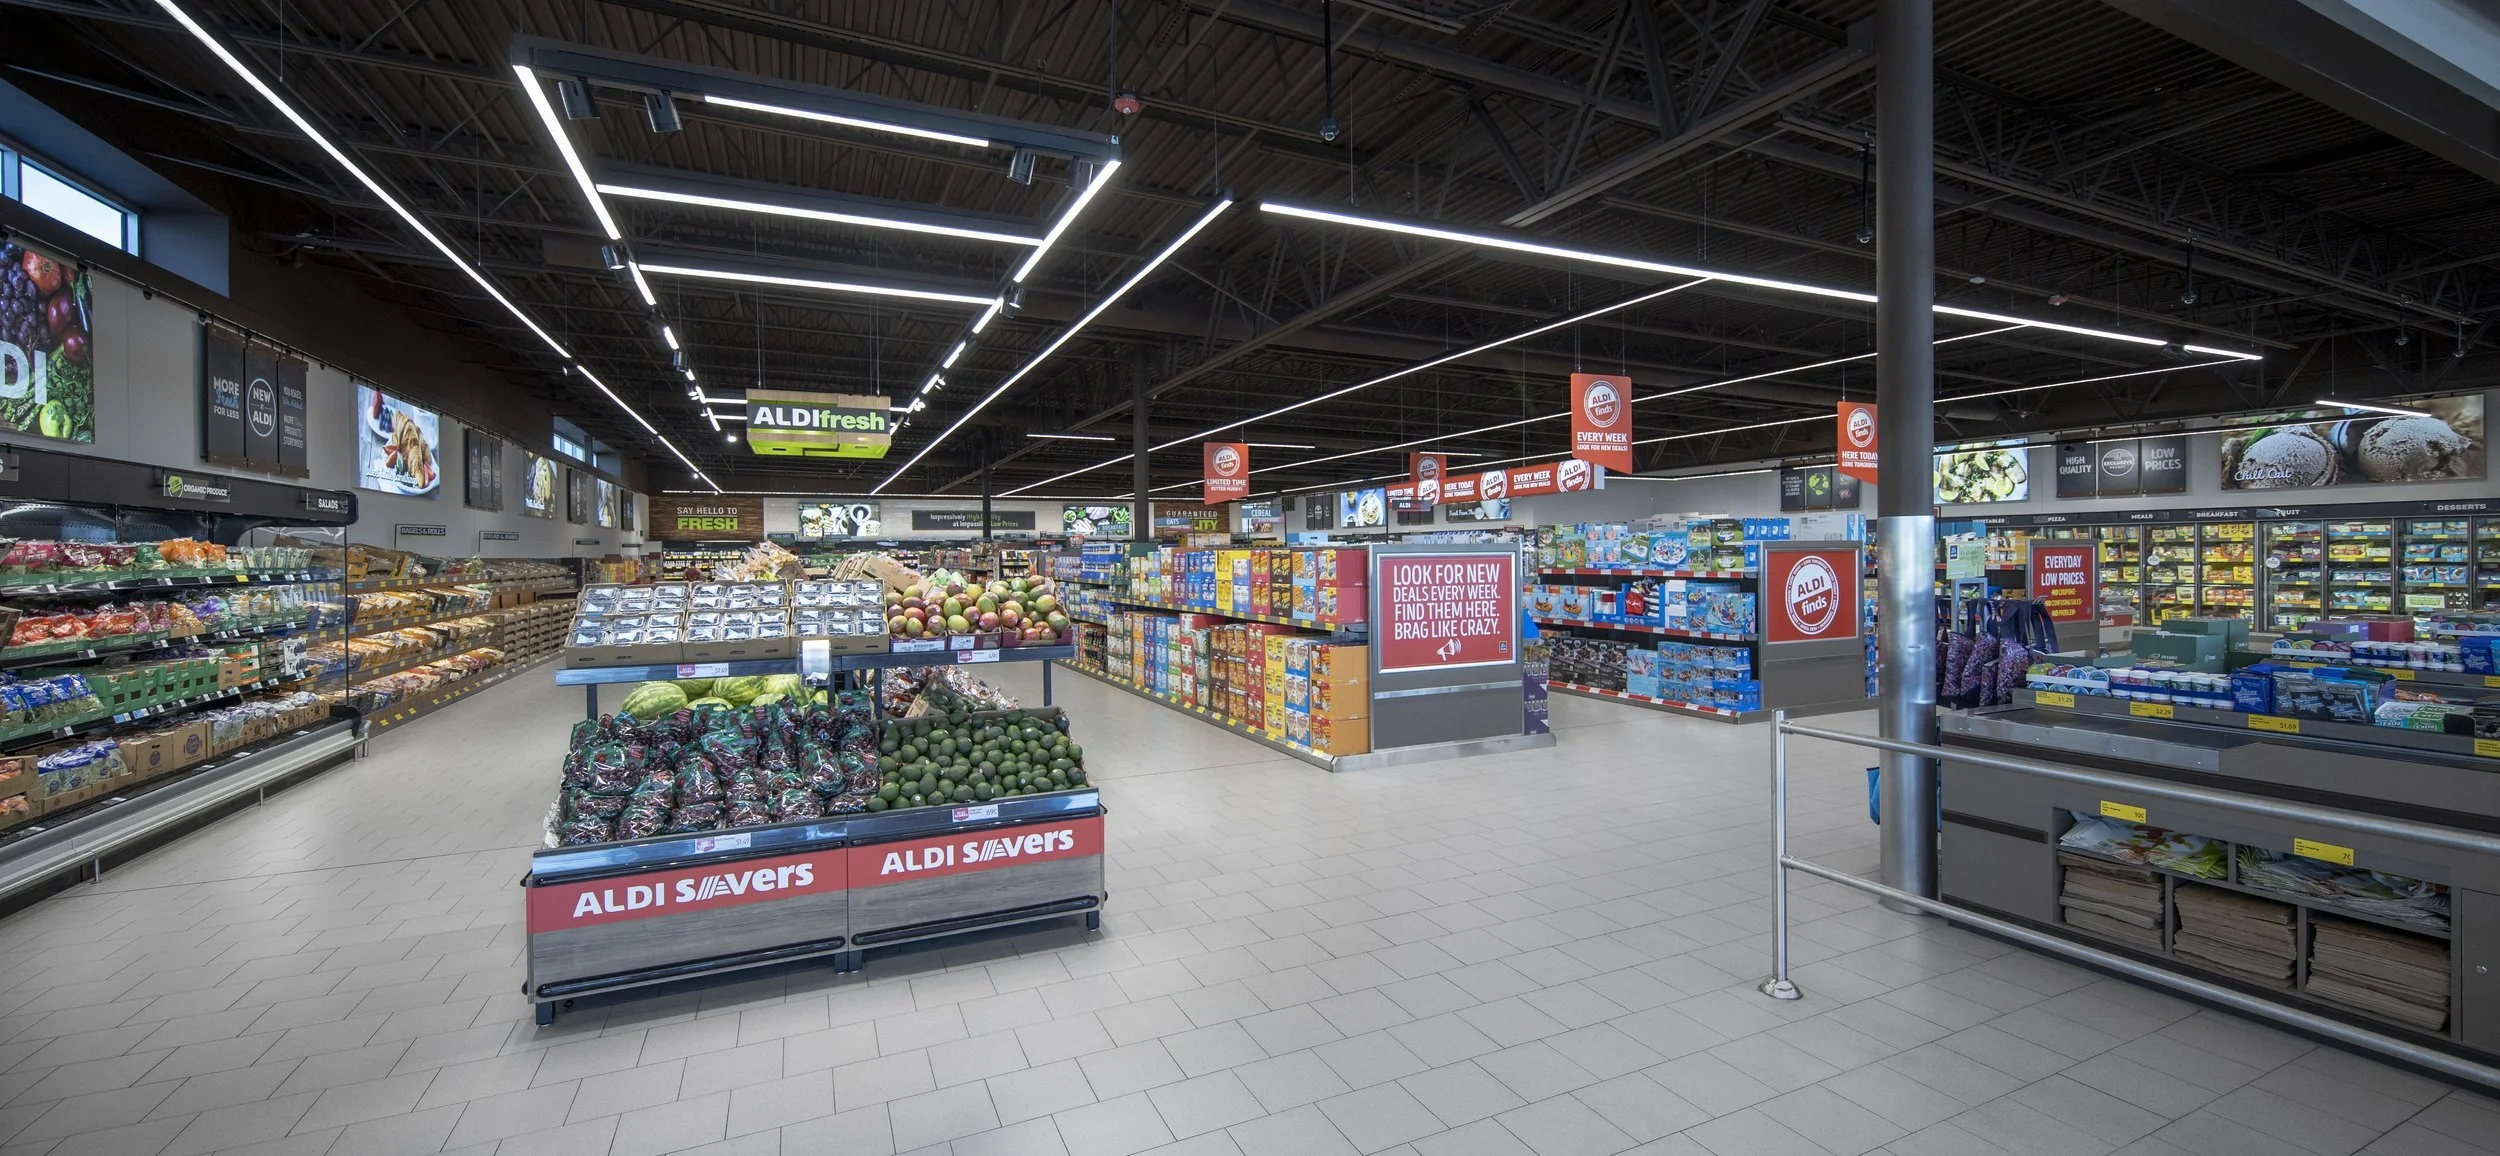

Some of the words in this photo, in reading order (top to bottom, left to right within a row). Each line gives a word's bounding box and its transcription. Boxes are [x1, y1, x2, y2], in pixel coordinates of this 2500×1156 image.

[214, 376, 240, 396] MORE
[216, 390, 240, 409] Fresh
[253, 387, 272, 404] NEW
[1592, 393, 1611, 405] ALDI
[214, 406, 226, 416] FOR
[226, 408, 240, 420] LESS
[1595, 405, 1613, 416] finds
[253, 412, 272, 426] ALDI
[284, 414, 295, 425] MORE
[1854, 419, 1867, 428] ALDI
[284, 426, 302, 438] PRODUCTS
[1577, 432, 1604, 442] EVERY
[1605, 433, 1627, 442] WEEK
[1855, 428, 1868, 438] finds
[283, 436, 303, 448] STOREWIDE
[1842, 451, 1858, 459] HERE
[2151, 448, 2175, 459] LOW
[2066, 456, 2085, 465] HIGH
[2145, 459, 2181, 471] PRICES
[1565, 464, 1582, 477] ALDI
[2060, 464, 2091, 475] QUALITY
[2235, 469, 2265, 480] Chill
[2268, 469, 2292, 478] Out
[1486, 475, 1500, 486] ALDI
[1514, 472, 1532, 483] EVERY
[1534, 470, 1550, 479] WEEK
[1566, 475, 1583, 488] finds
[184, 484, 206, 494] ORGANIC
[207, 487, 228, 496] PRODUCE
[1422, 483, 1434, 493] ALDI
[1458, 481, 1474, 489] TODAY
[1488, 485, 1501, 496] finds
[318, 498, 338, 509] SALADS
[930, 513, 966, 522] Impressively
[966, 514, 980, 522] High
[677, 518, 739, 530] FRESH
[2045, 555, 2082, 568] EVERYDAY
[1393, 564, 1432, 586] LOOK
[1436, 564, 1463, 584] FOR
[1467, 563, 1500, 582] NEW
[2041, 572, 2057, 586] LOW
[2059, 572, 2086, 585] PRICES.
[1798, 576, 1824, 597] ALDI
[1393, 586, 1428, 602] DEALS
[1431, 585, 1465, 601] EVERY
[1466, 584, 1501, 599] WEEK.
[1395, 603, 1425, 621] FIND
[1428, 602, 1462, 619] THEM
[1465, 600, 1500, 618] HERE.
[1802, 596, 1827, 616] finds
[1394, 621, 1428, 640] BRAG
[1431, 620, 1457, 638] LIKE
[1460, 618, 1500, 636] CRAZY.
[880, 845, 954, 875] ALDI
[573, 882, 664, 918] ALDI
